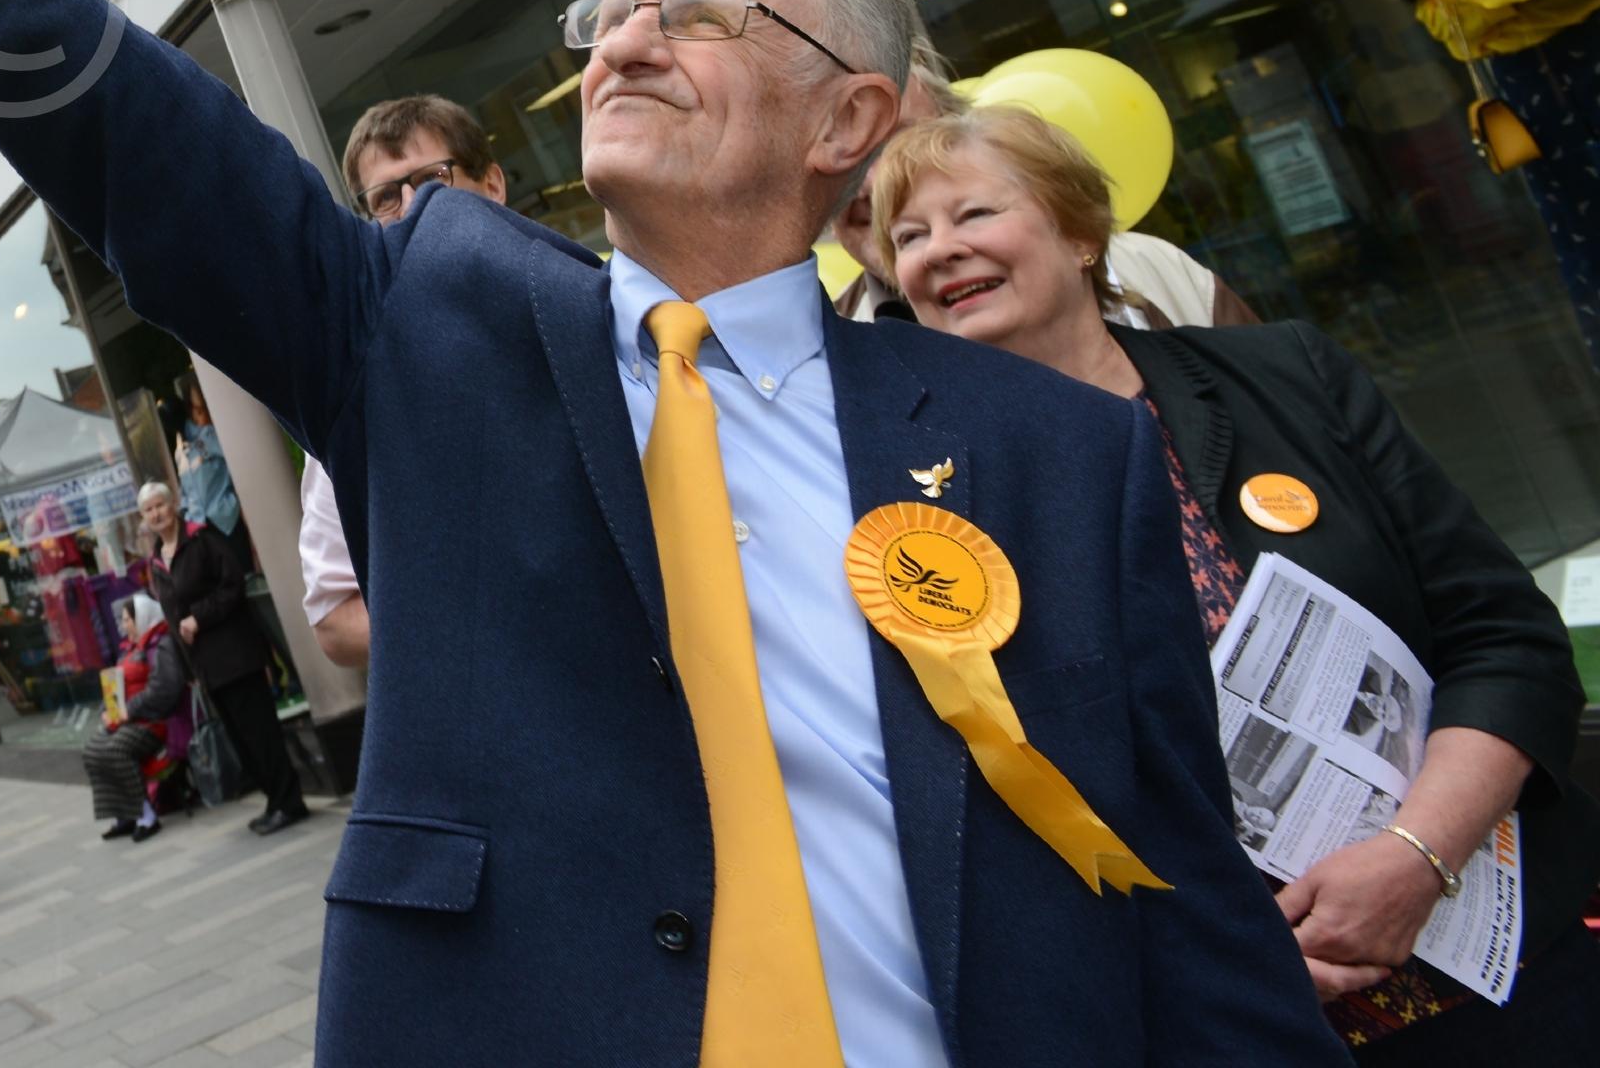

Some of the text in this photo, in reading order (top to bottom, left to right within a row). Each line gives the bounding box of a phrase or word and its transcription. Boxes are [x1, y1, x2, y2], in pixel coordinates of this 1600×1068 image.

[918, 595, 971, 616] DEMOCRATS
[919, 587, 953, 602] LIBERAL
[1479, 867, 1506, 981] back to politics
[1489, 874, 1516, 995] Bringing real life
